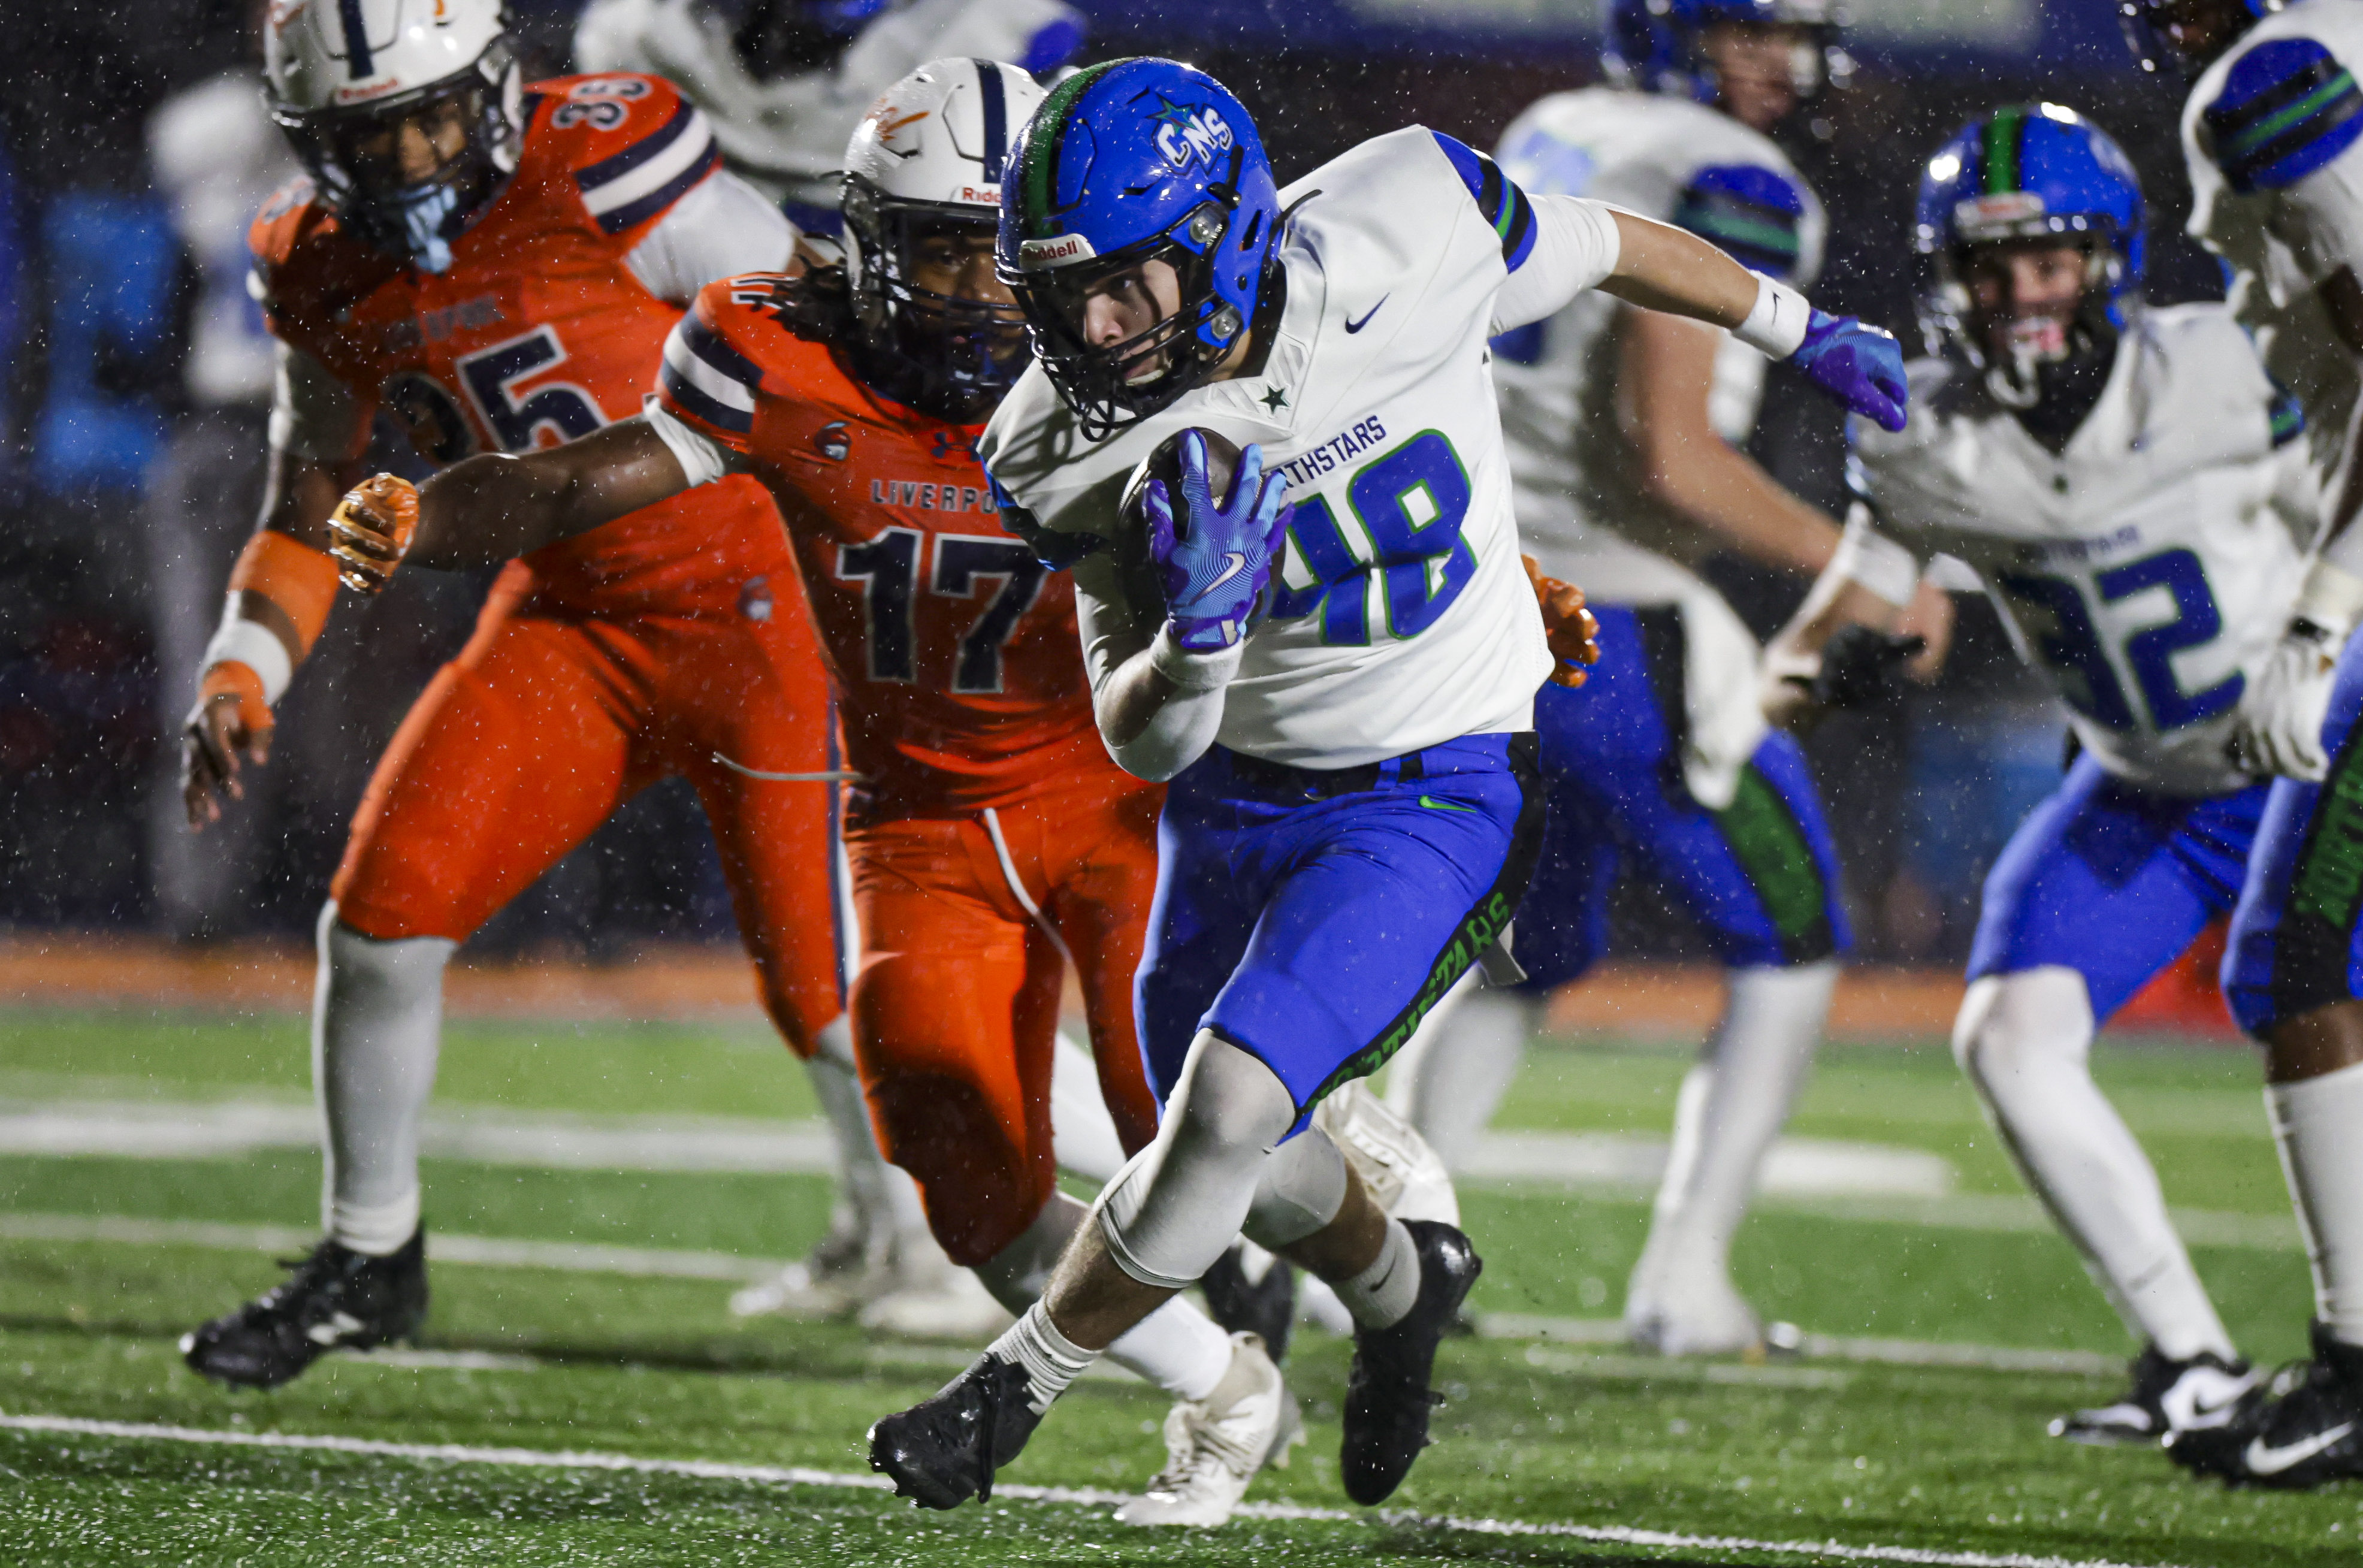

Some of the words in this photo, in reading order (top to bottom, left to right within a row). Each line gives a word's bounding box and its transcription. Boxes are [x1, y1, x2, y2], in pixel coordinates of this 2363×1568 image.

[1157, 107, 1233, 168] CNS
[835, 525, 1051, 694] 17
[1265, 428, 1479, 647] 48
[1996, 545, 2248, 733] 32
